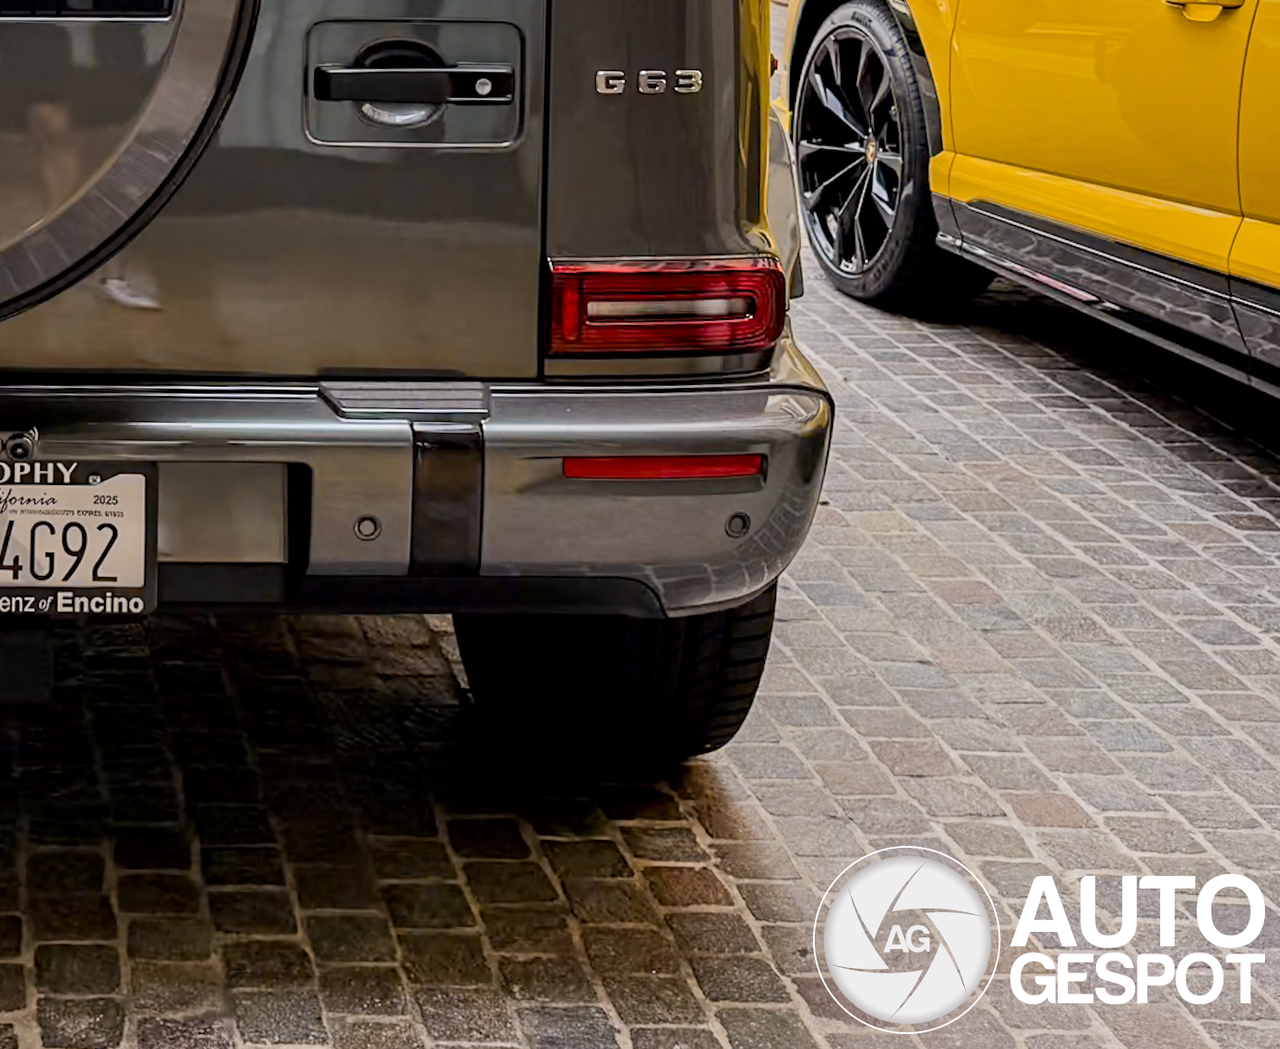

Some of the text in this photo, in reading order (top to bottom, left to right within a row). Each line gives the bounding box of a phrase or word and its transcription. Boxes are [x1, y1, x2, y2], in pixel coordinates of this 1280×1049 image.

[93, 495, 118, 505] 2025
[38, 595, 53, 614] of
[56, 592, 144, 614] Encino
